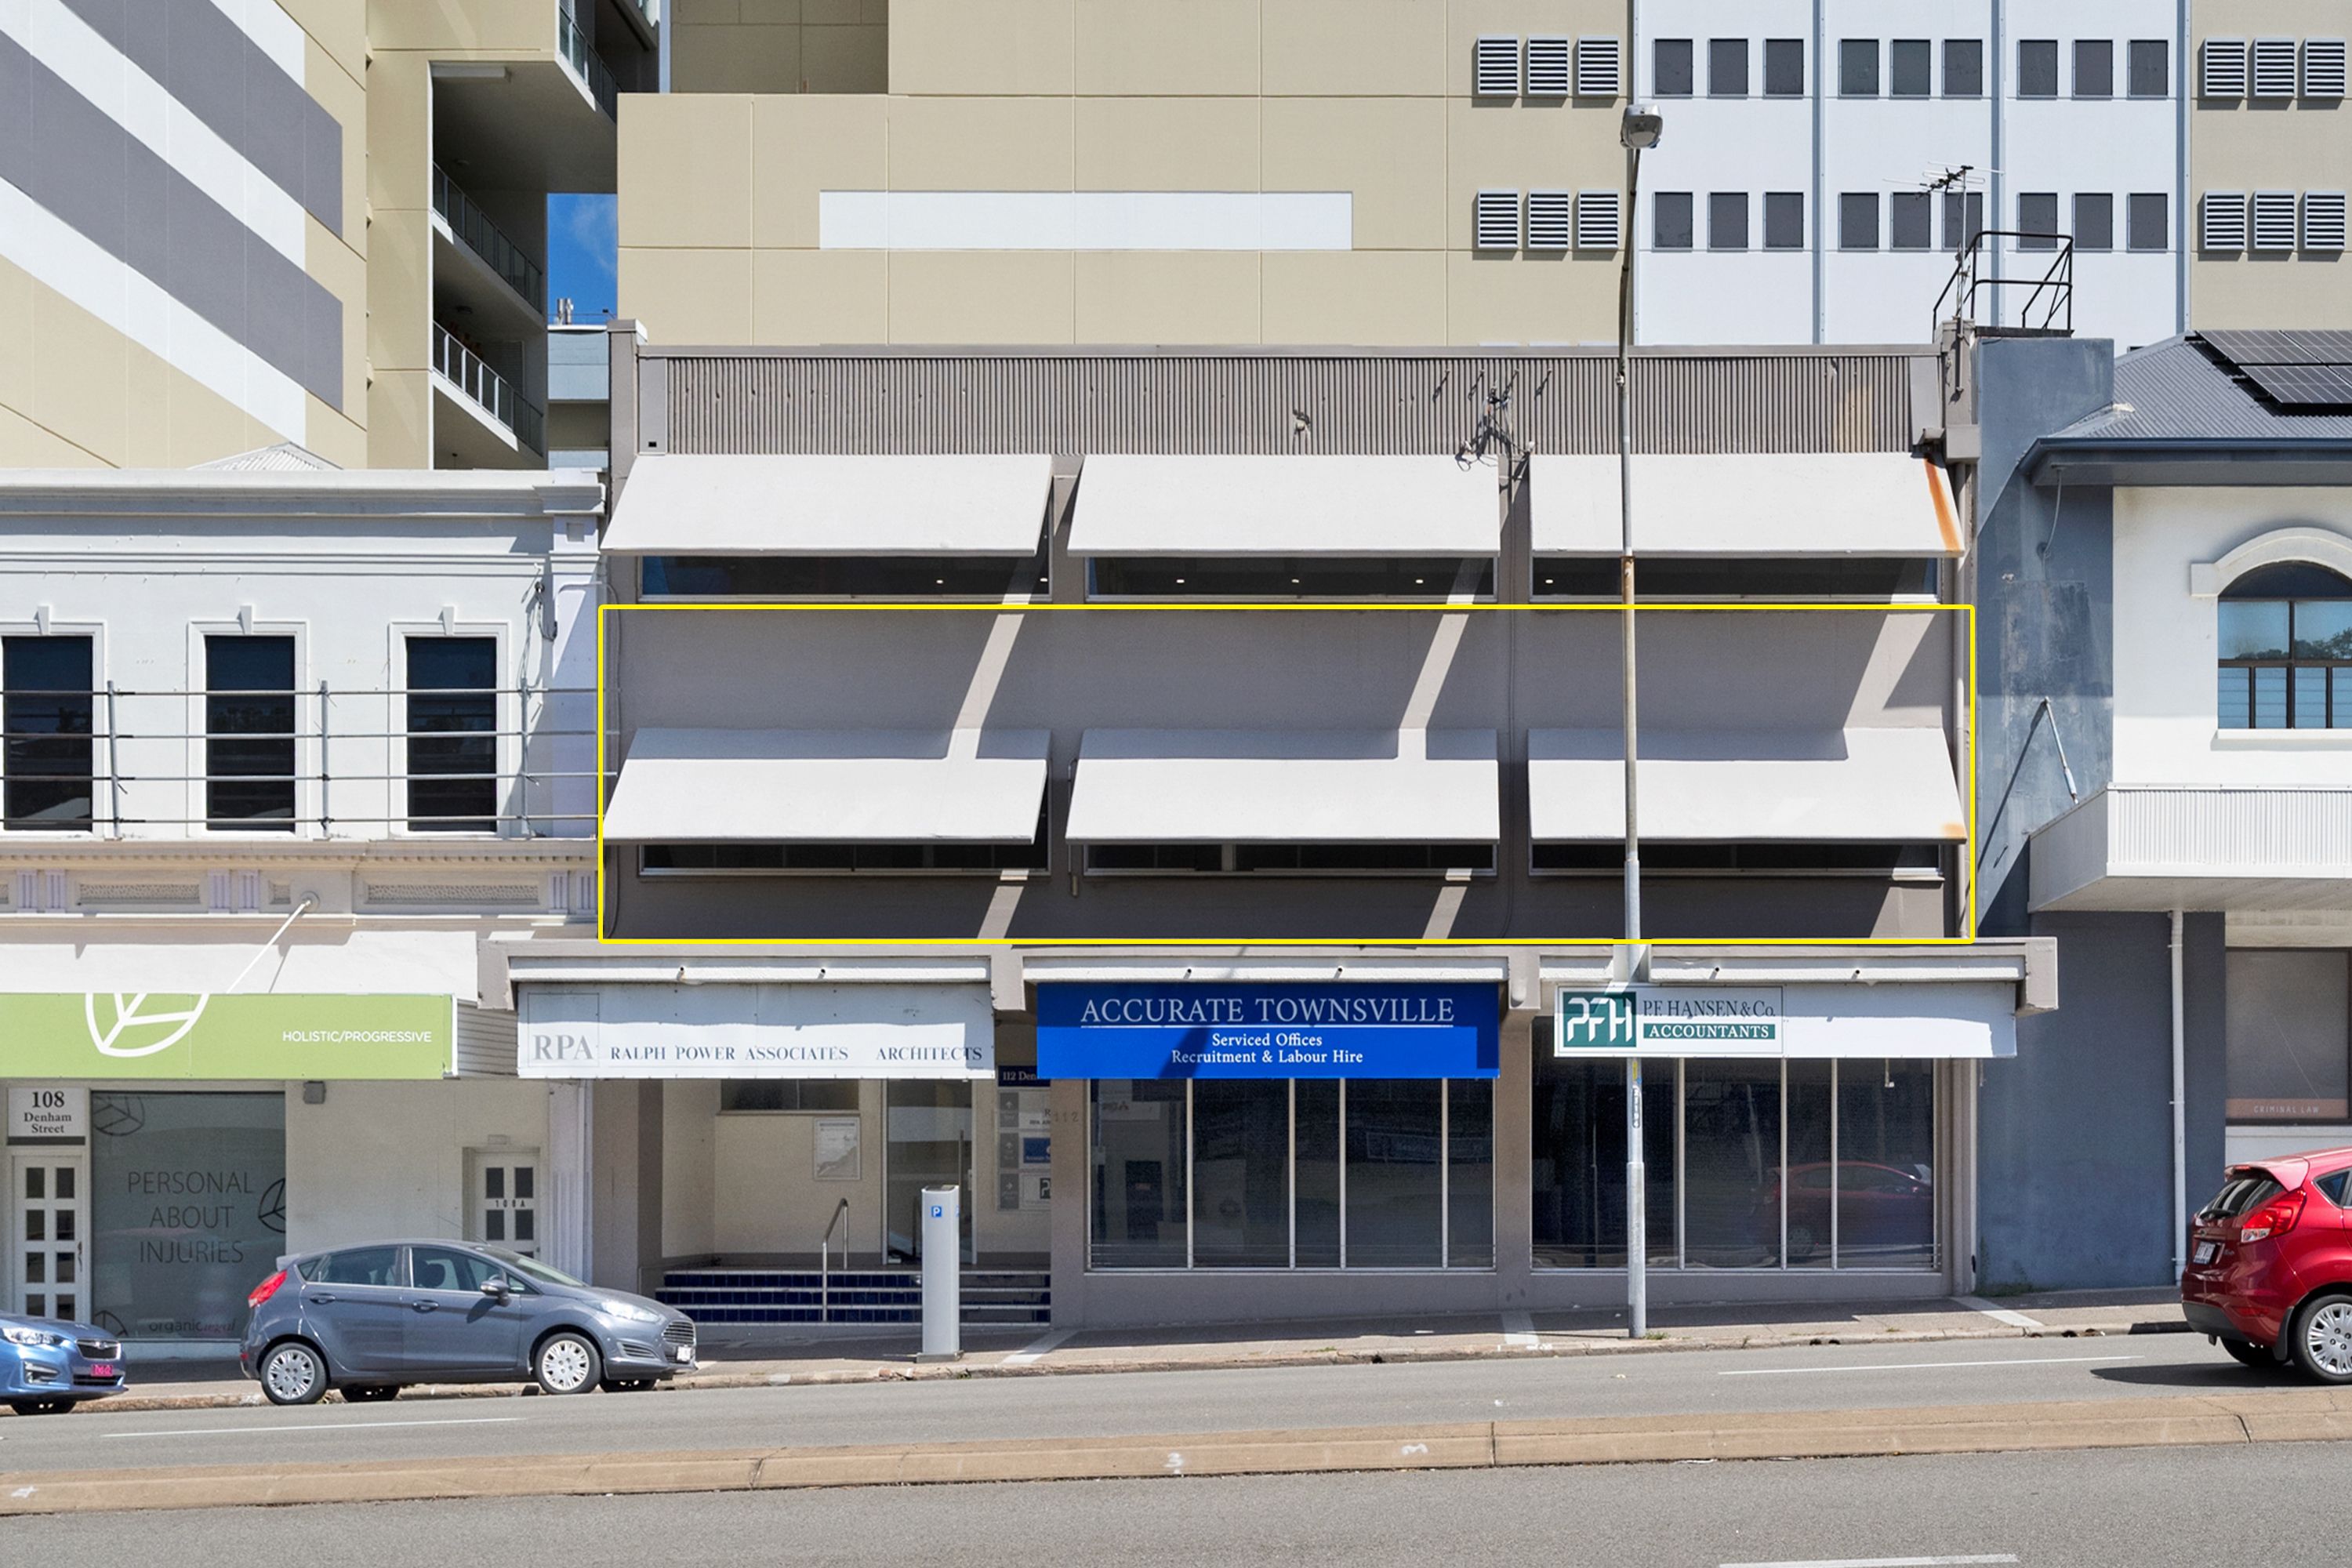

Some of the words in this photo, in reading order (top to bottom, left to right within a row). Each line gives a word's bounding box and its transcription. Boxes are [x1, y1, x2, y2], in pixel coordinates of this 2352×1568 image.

[1080, 998, 1244, 1022] ACCURATE
[1255, 998, 1454, 1022] TOWNSVILLE
[1568, 996, 1632, 1042] PFH
[282, 1030, 432, 1044] HOLISTIC/PROGRESSIVE
[1649, 1025, 1769, 1039] ACCOUNTANTS
[533, 1034, 593, 1060] RPA
[1212, 1033, 1270, 1047] Serviced
[1276, 1033, 1323, 1047] Offices
[611, 1047, 666, 1060] RALPH
[676, 1047, 735, 1060] POWER
[745, 1046, 848, 1061] ASSOCIATES
[876, 1046, 982, 1061] ARCHITECTS
[1172, 1049, 1256, 1063] Recruitment
[1261, 1050, 1272, 1063] &
[1279, 1049, 1327, 1063] Labour
[1333, 1049, 1363, 1063] Hire
[1003, 1071, 1017, 1081] 112
[32, 1091, 64, 1108] 108
[2253, 1105, 2296, 1113] CRIMINAL
[2300, 1105, 2319, 1113] LAW
[24, 1112, 71, 1122] Denham
[31, 1123, 64, 1134] Street
[128, 1171, 255, 1194] PERSONAL
[149, 1206, 234, 1229] ABOUT
[140, 1240, 245, 1264] INJURIES
